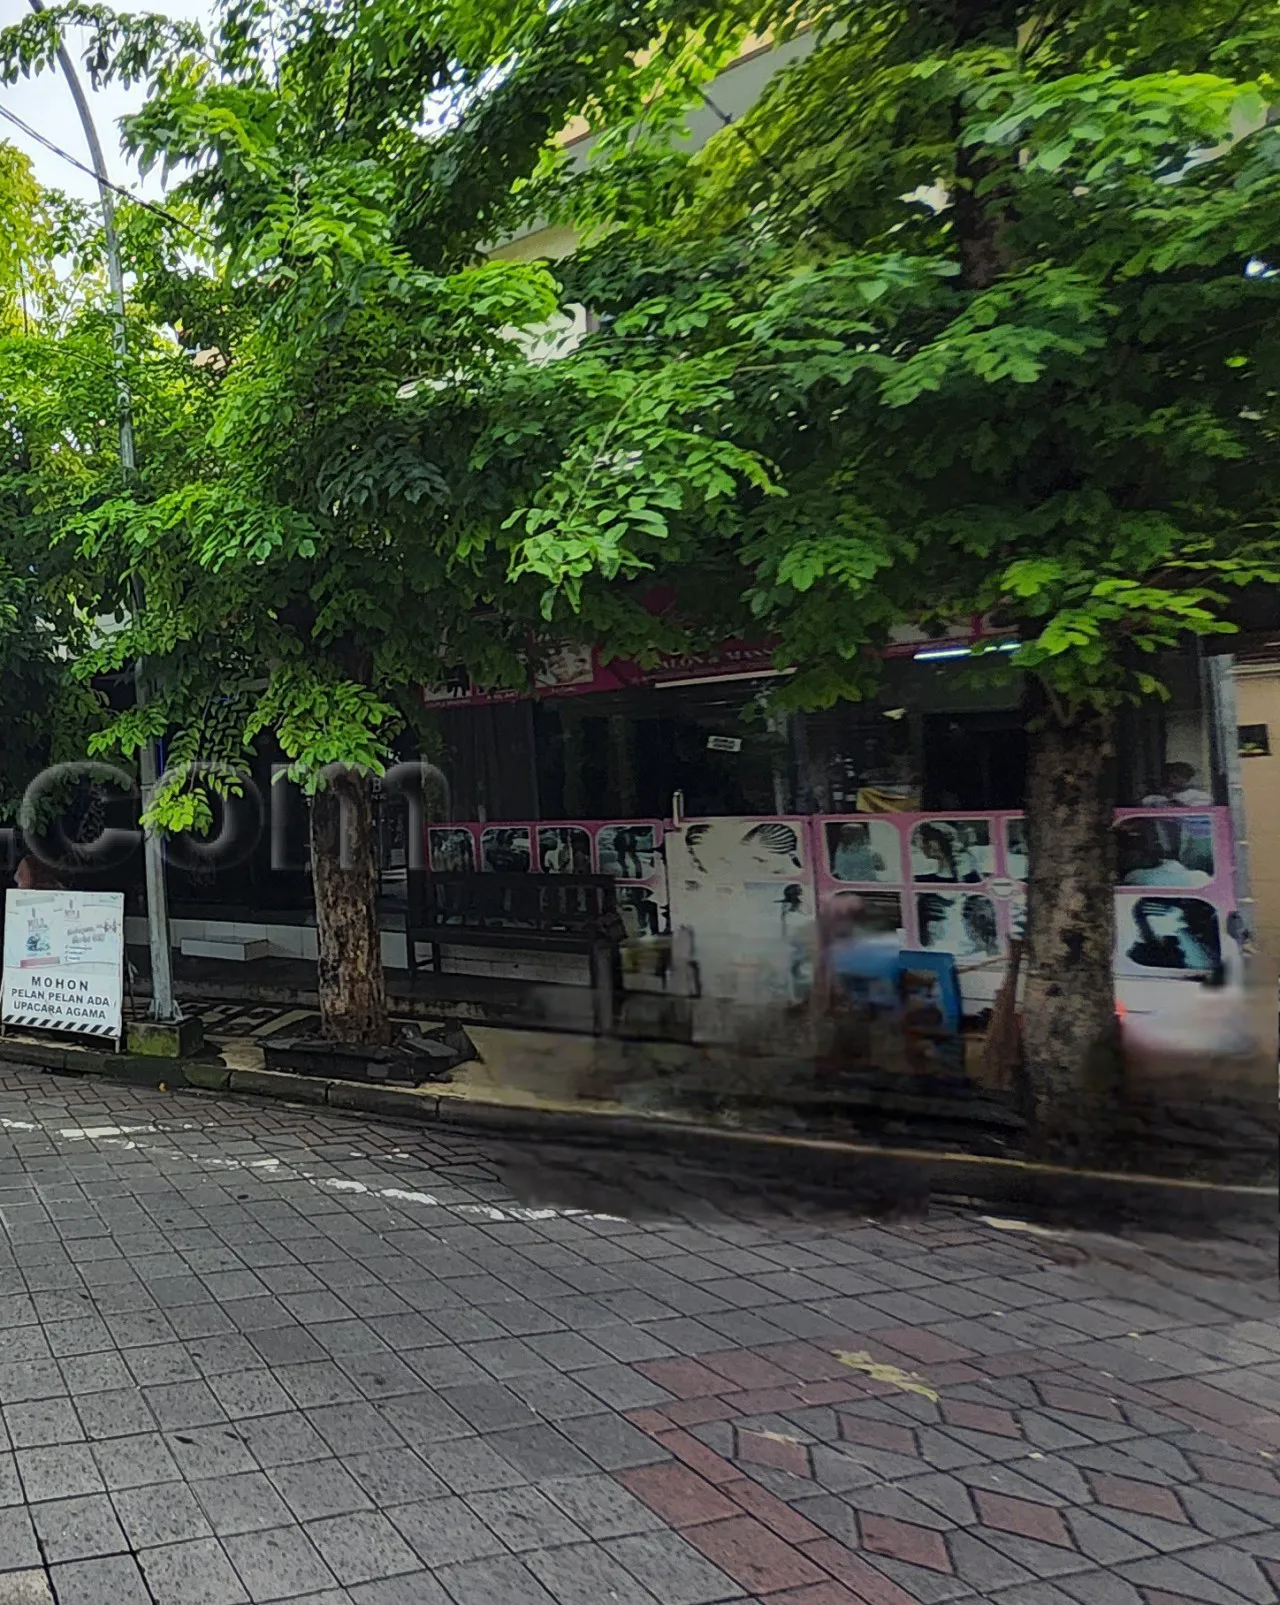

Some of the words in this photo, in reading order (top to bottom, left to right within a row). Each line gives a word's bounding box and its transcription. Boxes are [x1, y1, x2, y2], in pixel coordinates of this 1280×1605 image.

[31, 976, 89, 991] MOHON
[11, 988, 45, 1000] PELAN
[48, 992, 83, 1004] PELAN
[87, 997, 110, 1007] ADA
[13, 1001, 63, 1015] UPACARA
[66, 1007, 107, 1020] AGAMA
